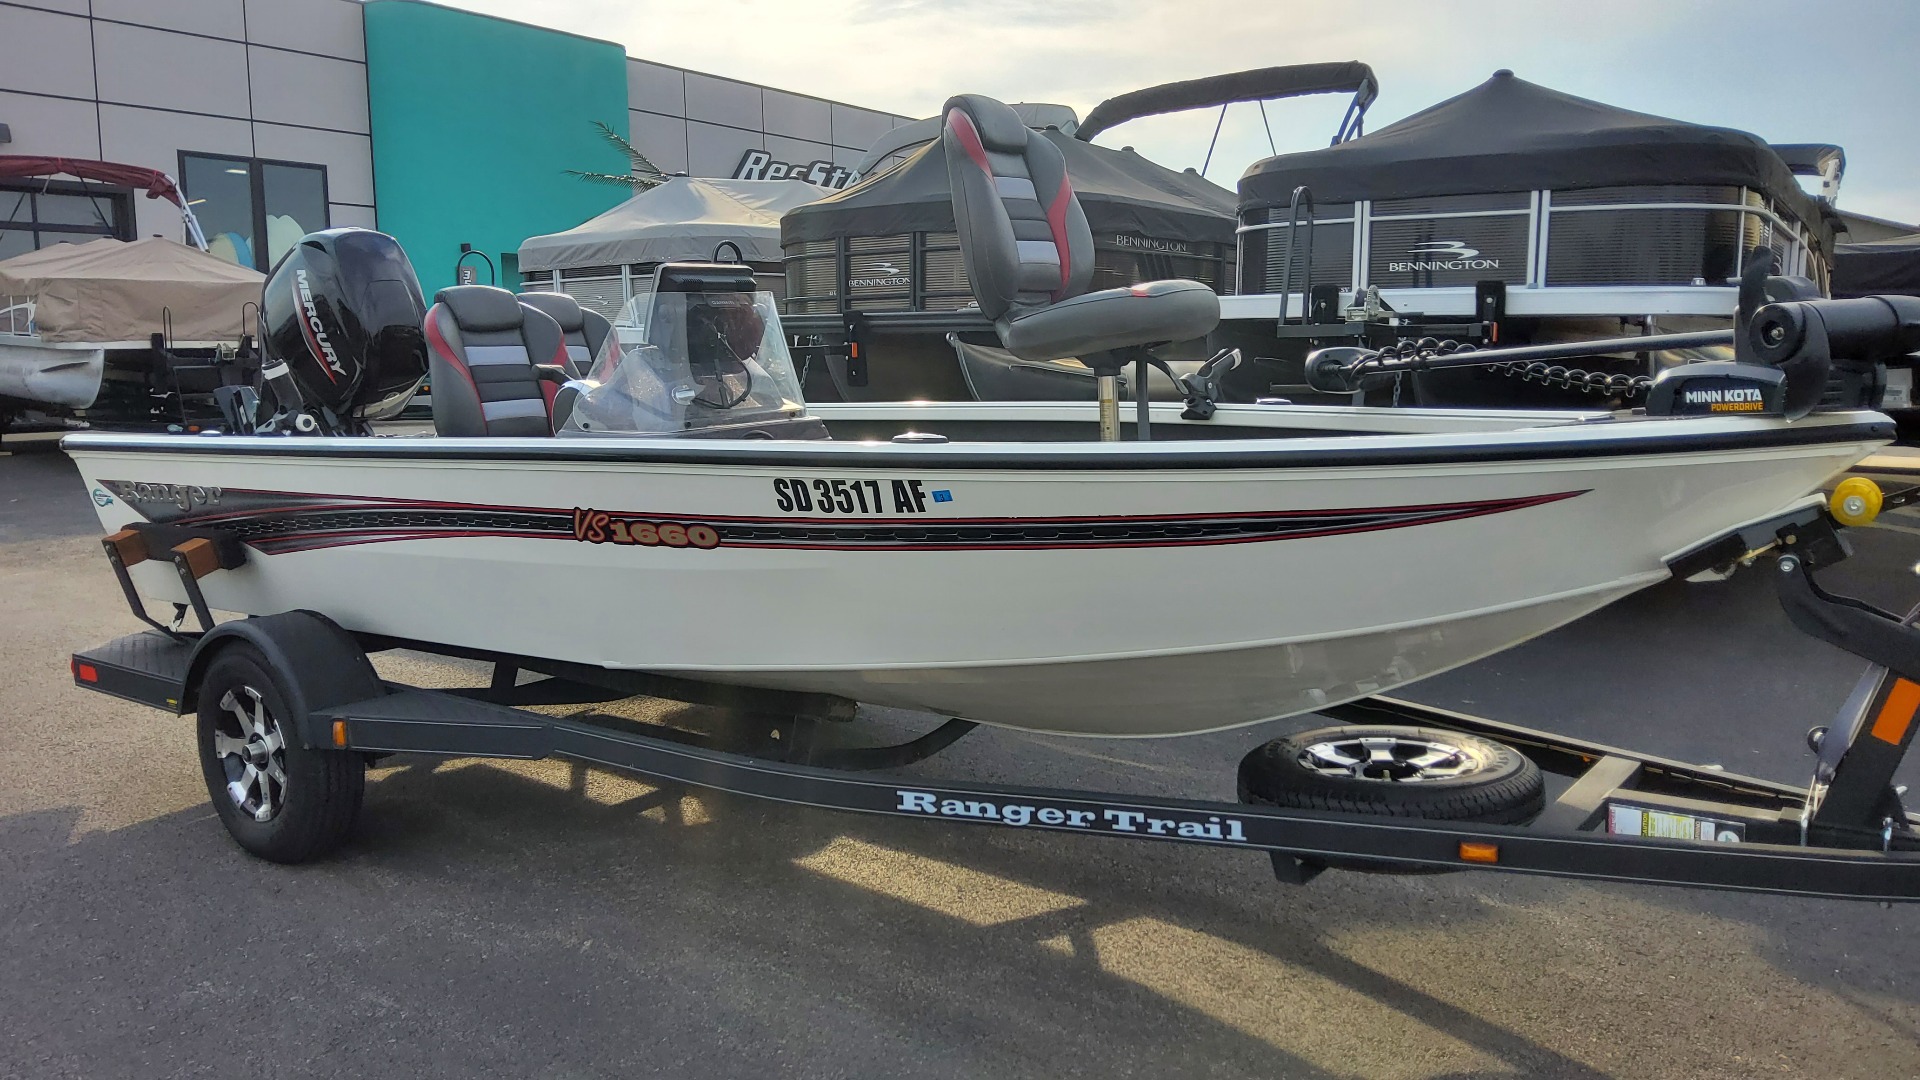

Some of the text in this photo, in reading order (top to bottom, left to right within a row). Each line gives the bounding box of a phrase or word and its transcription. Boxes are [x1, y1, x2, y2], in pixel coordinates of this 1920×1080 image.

[1116, 234, 1187, 252] BENNINGTON
[1389, 259, 1499, 272] BENNINGTON
[848, 277, 911, 288] BENNINGTON
[296, 269, 347, 376] MERCURY
[1685, 388, 1763, 403] MINN KOTA
[1711, 402, 1764, 411] POWERDRIVE
[118, 480, 222, 512] Ranger
[773, 478, 927, 514] SD 3517 AF
[573, 507, 720, 550] VS 1660
[896, 790, 1247, 842] Ranger Trail
